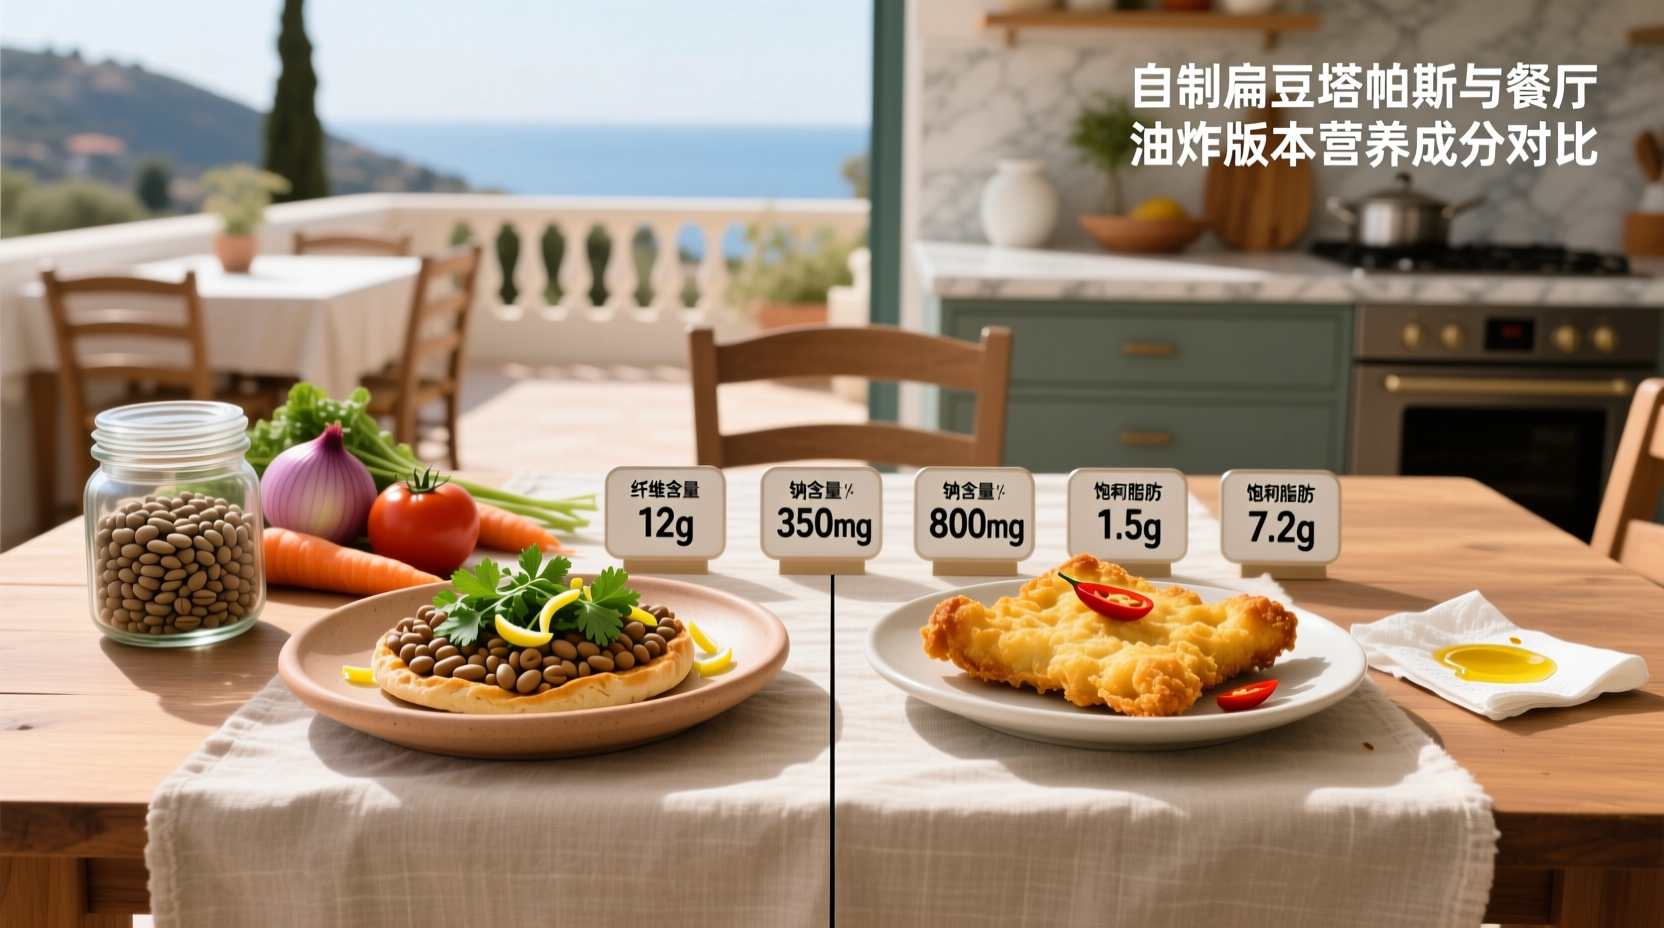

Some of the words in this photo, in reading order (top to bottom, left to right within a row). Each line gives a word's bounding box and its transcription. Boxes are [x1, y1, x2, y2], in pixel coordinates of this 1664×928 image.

[630, 479, 700, 499] 纤维含量
[638, 506, 694, 547] 12g
[776, 507, 872, 547] 350mg
[929, 507, 1025, 548] 800mg
[1098, 508, 1162, 550] 1.5g
[1248, 510, 1315, 552] 7.2g
